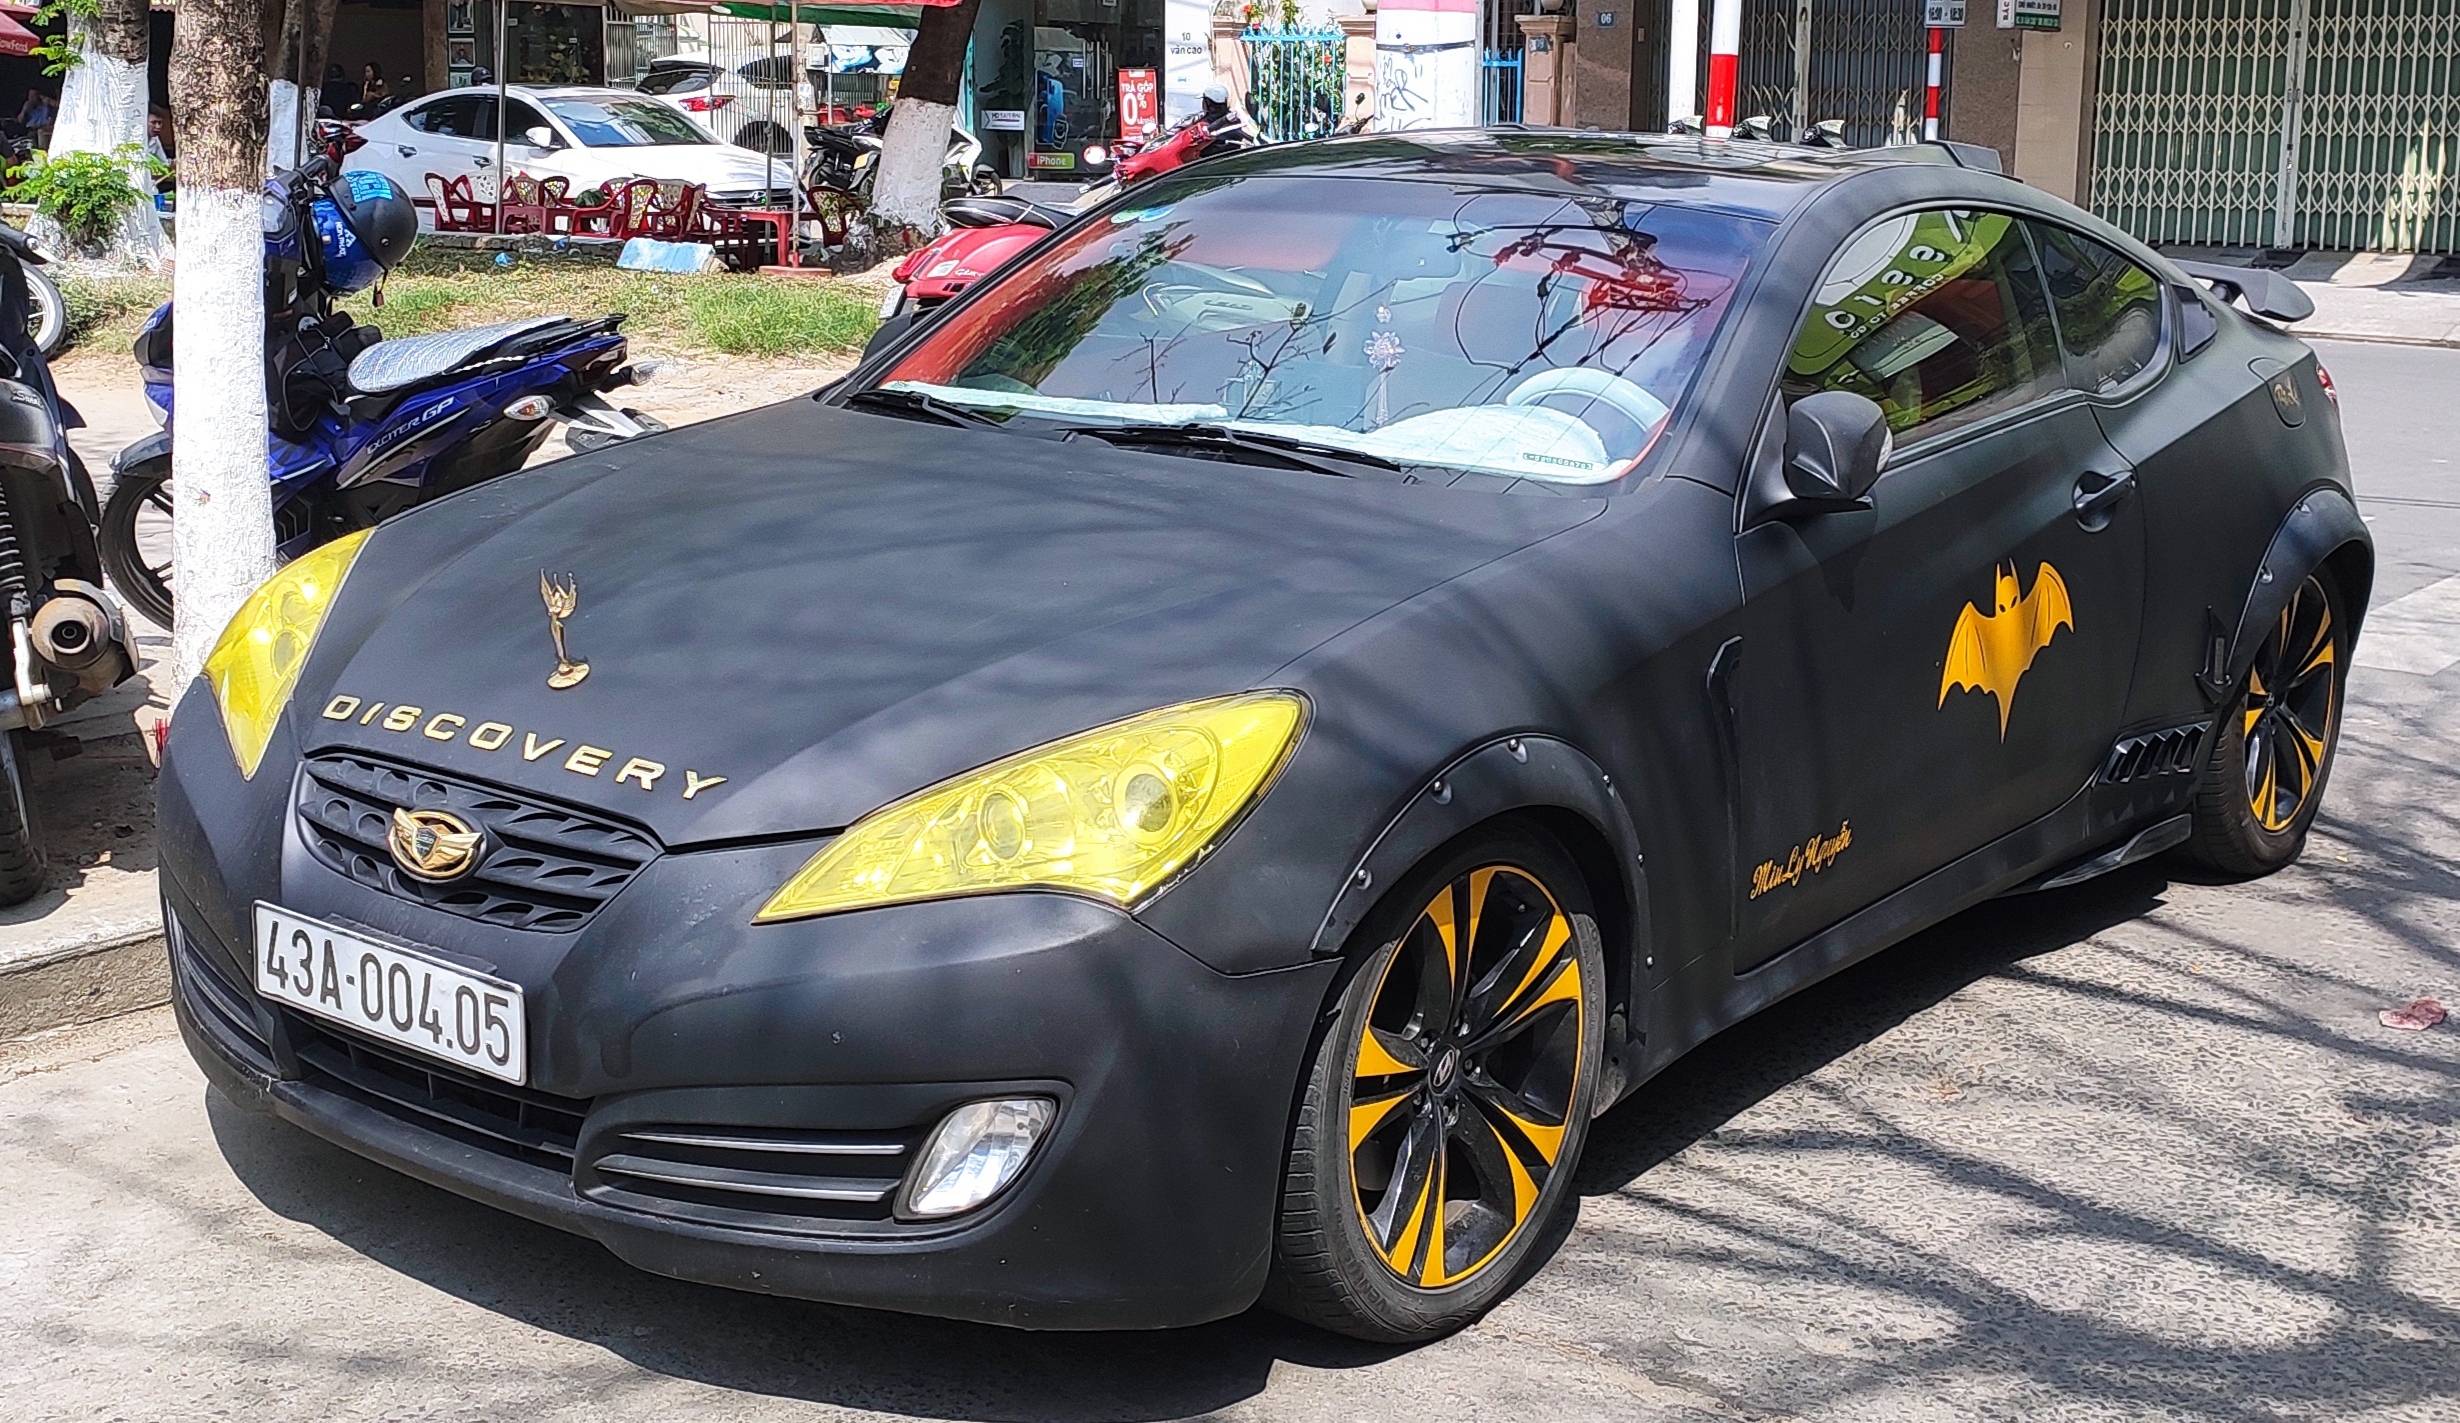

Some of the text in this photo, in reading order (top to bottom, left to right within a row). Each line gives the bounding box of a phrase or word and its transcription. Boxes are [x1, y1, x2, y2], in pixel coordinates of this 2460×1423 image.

[1600, 13, 1612, 24] 06
[1182, 32, 1191, 41] 10
[1186, 47, 1202, 55] cao
[1036, 154, 1067, 166] iPhone
[422, 396, 455, 421] GP
[322, 694, 728, 800] DISCOVERY
